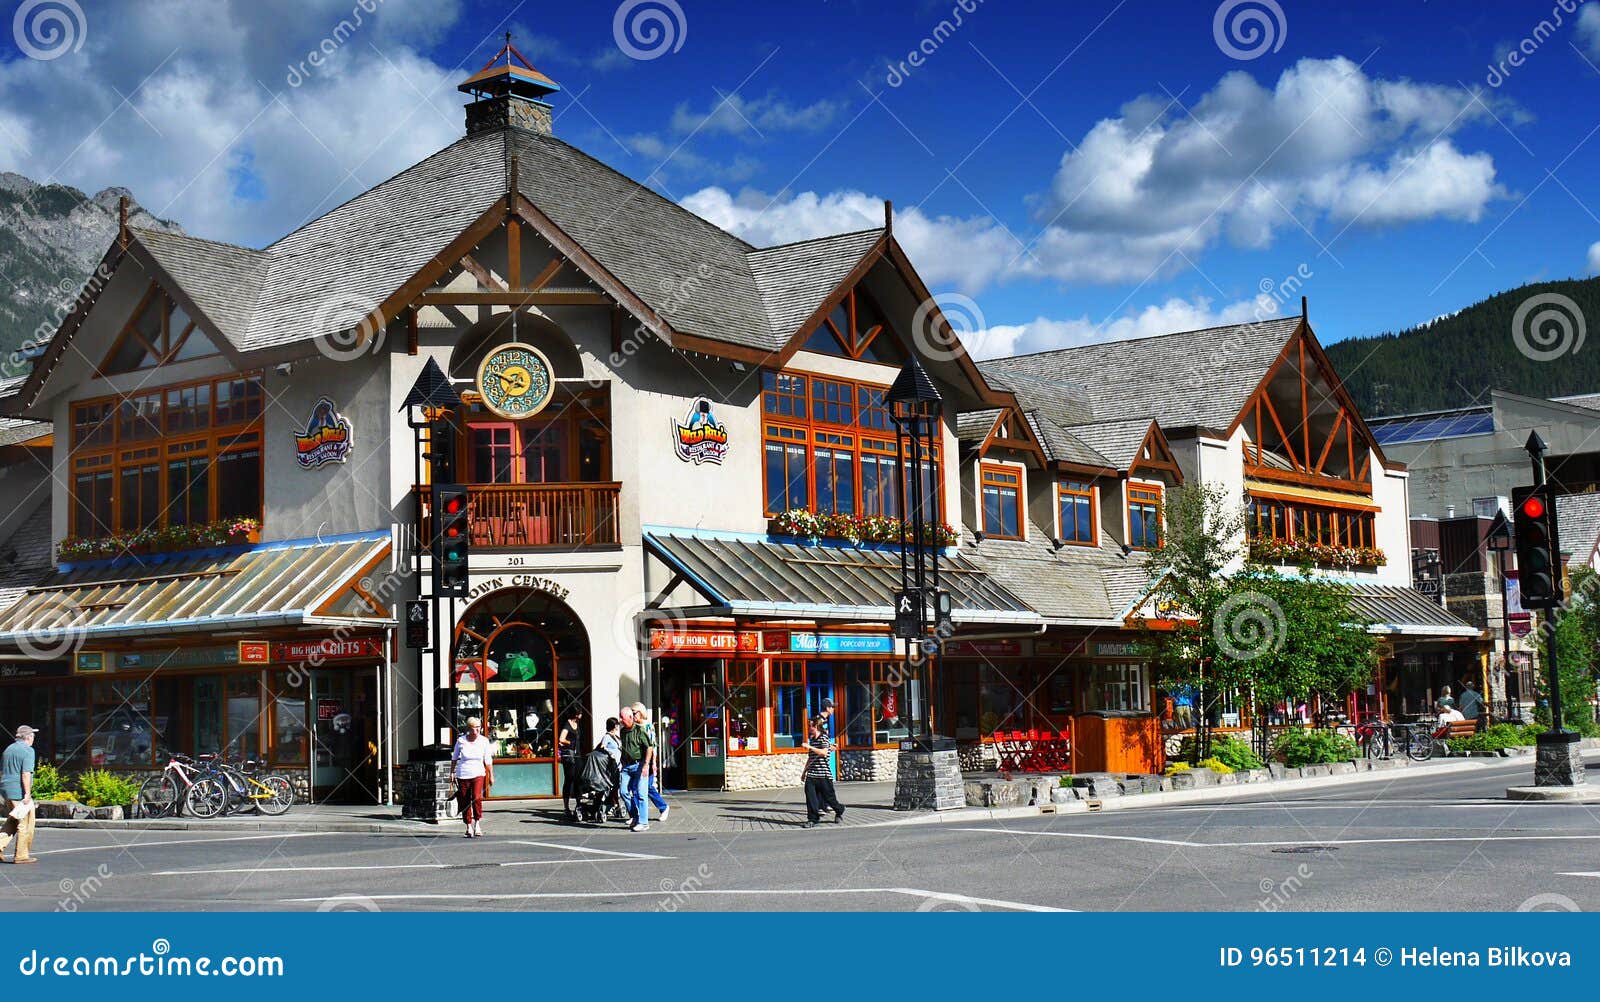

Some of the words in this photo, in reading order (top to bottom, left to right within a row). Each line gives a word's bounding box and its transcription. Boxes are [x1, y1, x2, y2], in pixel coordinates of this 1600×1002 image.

[509, 352, 521, 361] 12
[507, 557, 525, 566] 201
[458, 577, 504, 606] TOWN
[511, 575, 571, 600] CENTRE
[291, 646, 304, 655] BIG
[306, 645, 327, 655] HORN
[329, 642, 360, 656] GIFTS
[672, 636, 686, 647] BIG
[686, 636, 707, 647] HORN
[710, 635, 738, 650] GIFTS
[795, 634, 830, 653] Mary's
